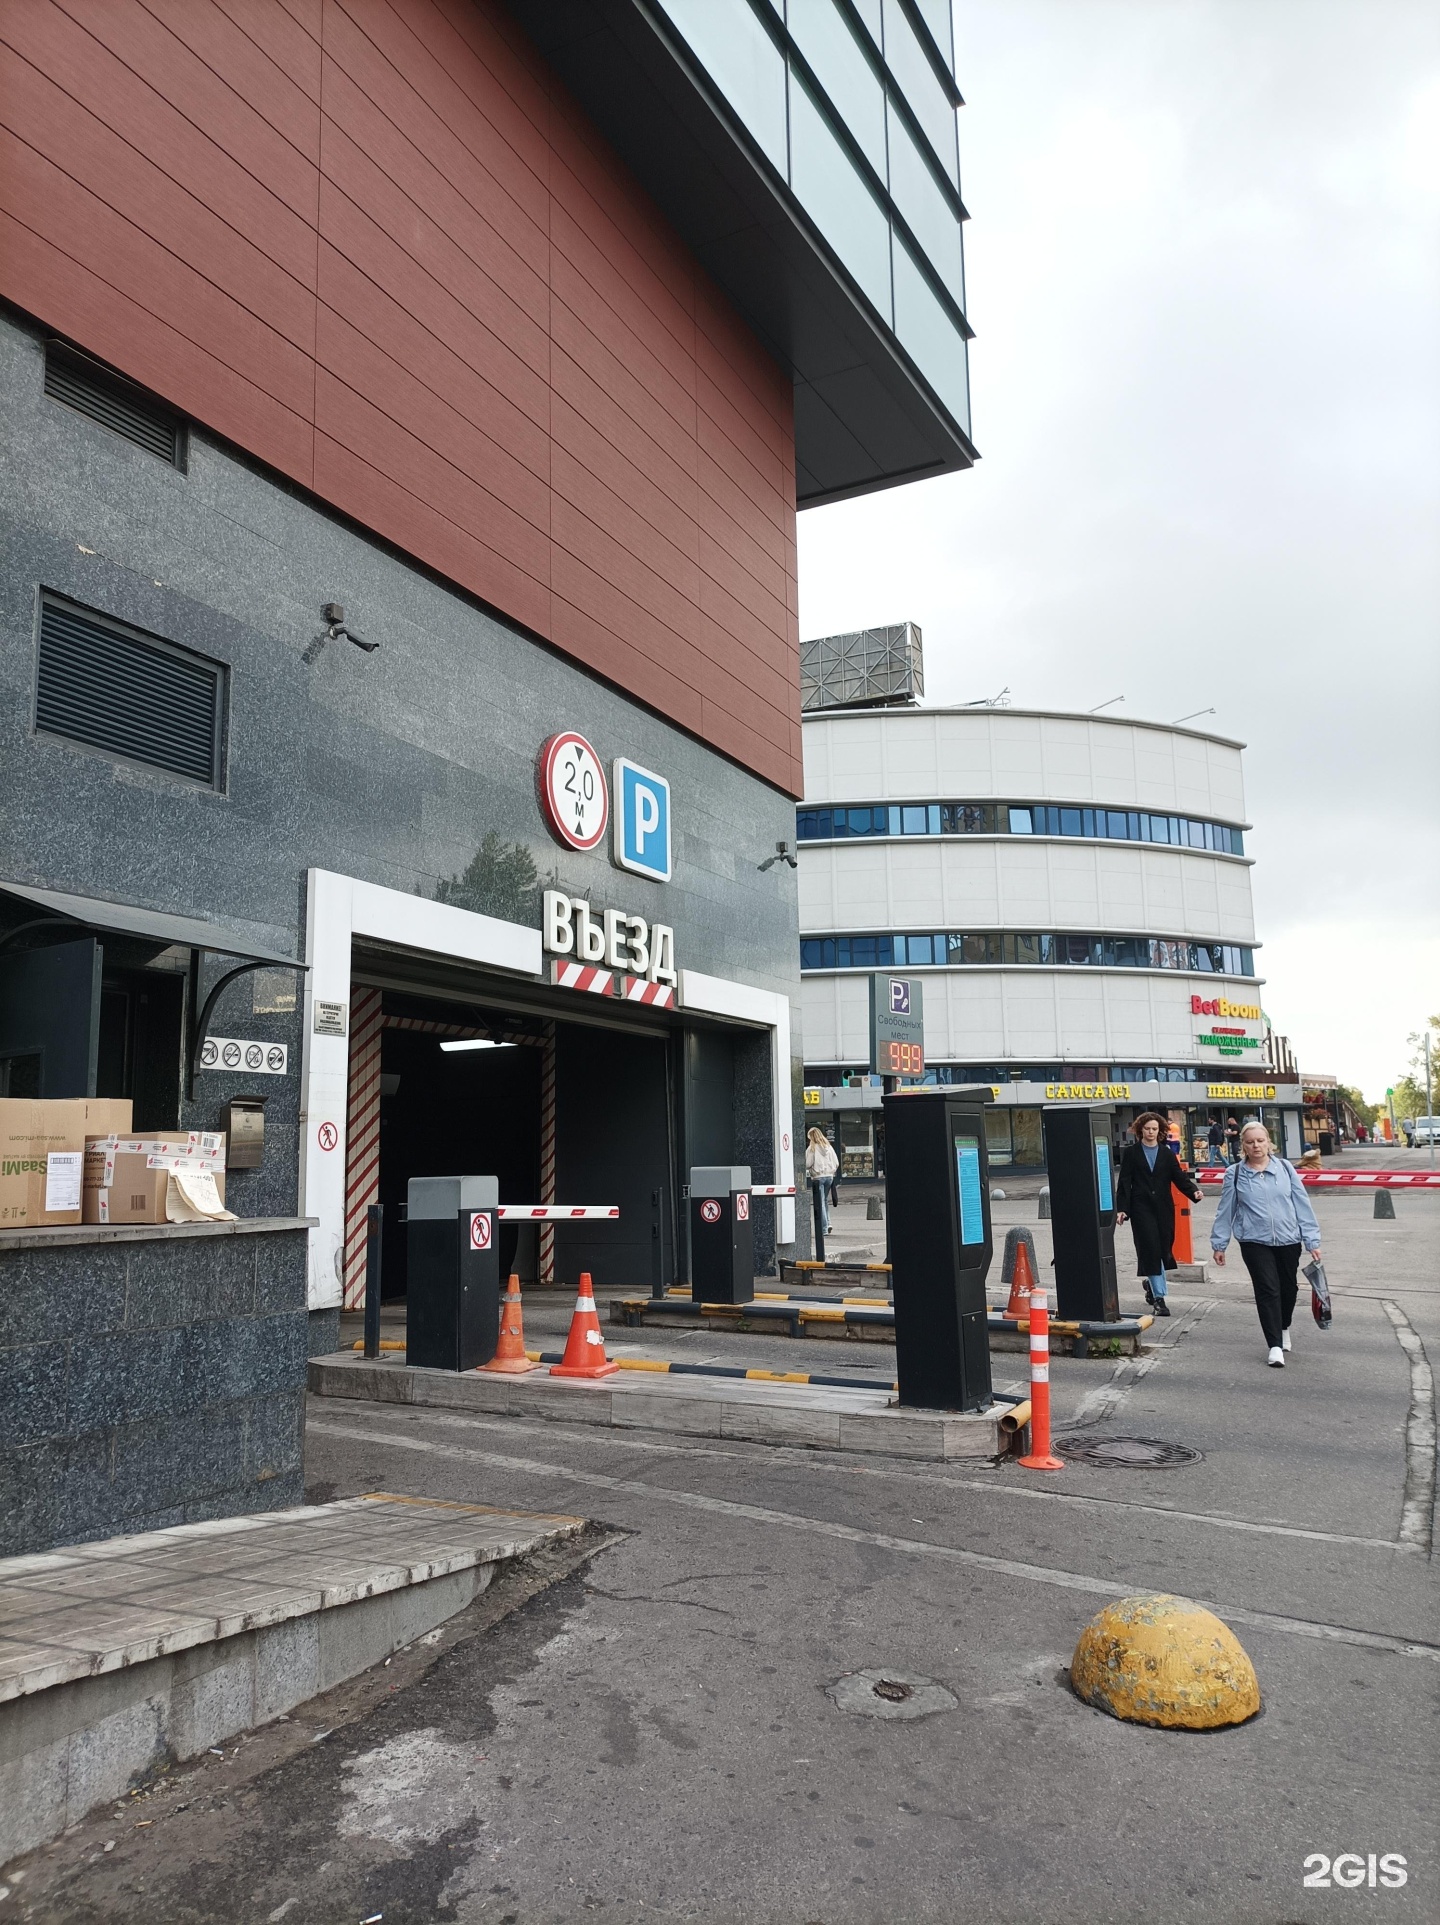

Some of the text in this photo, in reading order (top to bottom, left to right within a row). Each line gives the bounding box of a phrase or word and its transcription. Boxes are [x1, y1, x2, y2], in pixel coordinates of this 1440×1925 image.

[564, 761, 594, 802] 2,0
[543, 890, 678, 989] ВЪЕЗД
[1191, 995, 1261, 1020] BetBoom
[877, 1014, 922, 1029] Свободных
[890, 1031, 910, 1041] мест
[1199, 1034, 1259, 1048] ТАМОЖЕННЫХ
[890, 1042, 921, 1073] 999
[1046, 1084, 1132, 1099] САМСА №1
[1208, 1085, 1264, 1099] ПЕКАРНЯ
[9, 1135, 67, 1143] www.saa-mi.com
[1, 1160, 48, 1176] SaaMi
